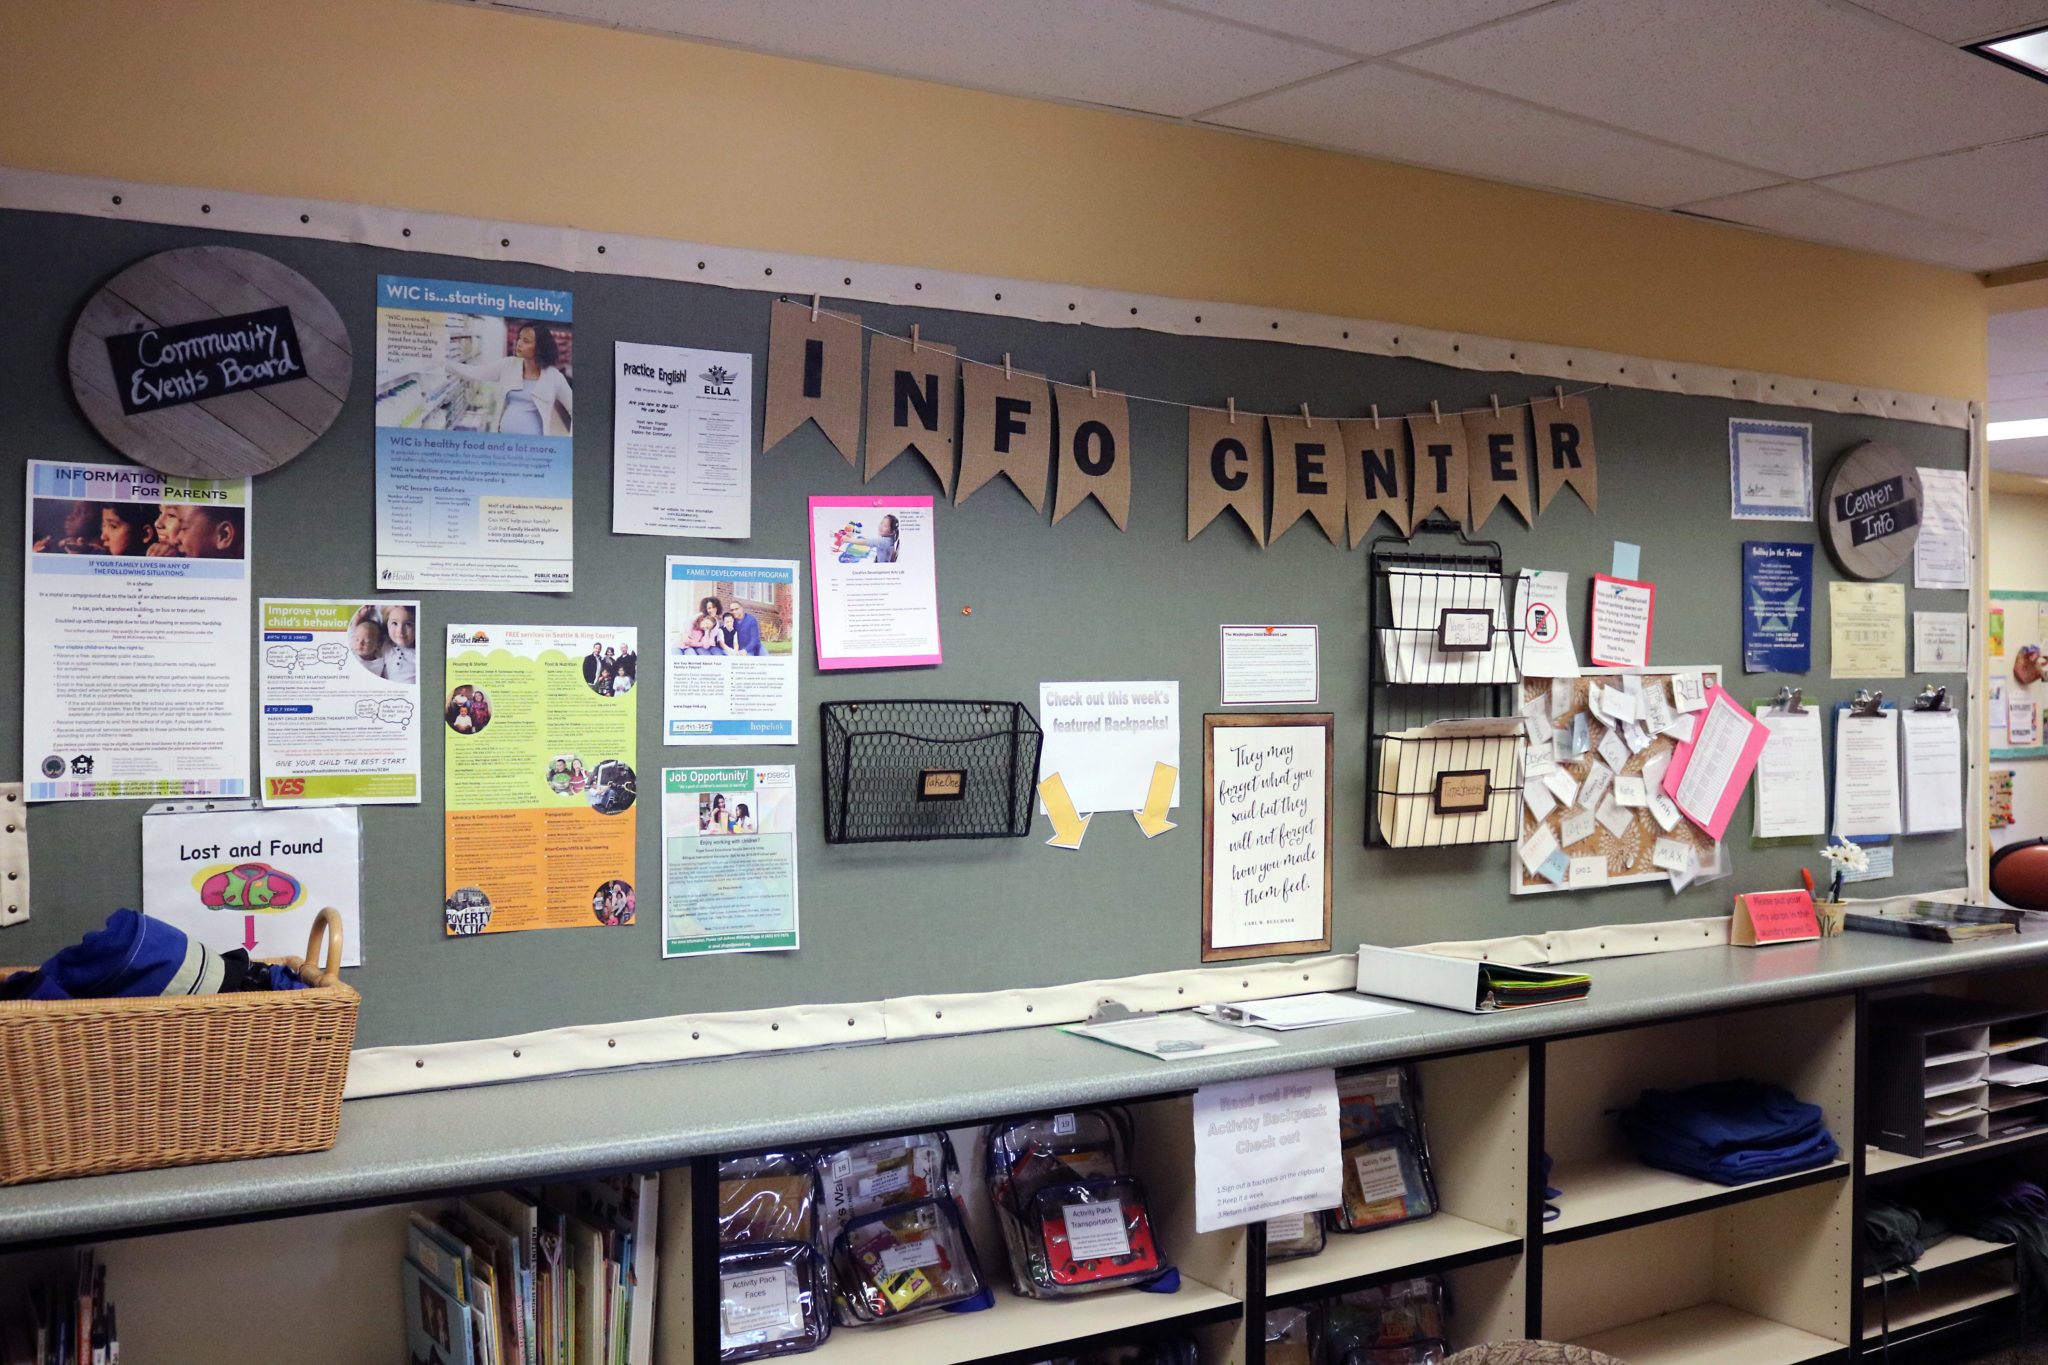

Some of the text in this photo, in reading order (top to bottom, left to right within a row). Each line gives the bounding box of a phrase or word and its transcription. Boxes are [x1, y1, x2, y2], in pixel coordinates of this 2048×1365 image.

[386, 285, 420, 299] WIC
[509, 295, 564, 316] healthy.
[139, 323, 277, 367] Community
[131, 341, 299, 405] Events Board
[624, 363, 686, 386] Practice English!
[704, 386, 731, 396] ELLA
[803, 340, 1115, 476] INFO
[390, 437, 412, 447] WIC
[415, 438, 421, 447] is
[424, 438, 460, 451] healthy
[463, 440, 485, 449] food
[487, 441, 505, 450] and
[515, 442, 527, 452] lot
[530, 445, 557, 453] more.
[1210, 423, 1582, 499] CENTER
[56, 468, 167, 484] INFORMATION
[164, 487, 227, 499] PARENTS
[1845, 484, 1894, 516] Center
[1861, 511, 1895, 540] Info
[711, 569, 756, 578] DEVELOPMENT
[268, 617, 348, 628] child's behavior
[269, 606, 336, 618] Improve your
[1046, 690, 1169, 706] Check out this week's
[750, 722, 783, 732] hopelink
[1053, 716, 1168, 734] featured Backpacks!
[1230, 744, 1294, 771] They may
[270, 778, 305, 796] YES
[669, 770, 749, 784] Job Opportunity!
[1219, 769, 1314, 805] forget what you
[1232, 796, 1307, 824] said but they
[1229, 818, 1316, 852] will not forget
[180, 838, 323, 860] Lost and Found
[1232, 843, 1318, 882] how you made
[1245, 874, 1310, 906] them feel.
[447, 911, 490, 925] POVERTY
[1220, 1086, 1312, 1111] Read and Play
[1208, 1104, 1327, 1136] Activity Backpack
[1236, 1130, 1300, 1154] Check out
[1252, 1176, 1278, 1186] backpack
[1298, 1167, 1325, 1177] clipboard
[1072, 1218, 1117, 1228] Transportation
[732, 1279, 757, 1288] Activity
[745, 1290, 766, 1298] Faces
